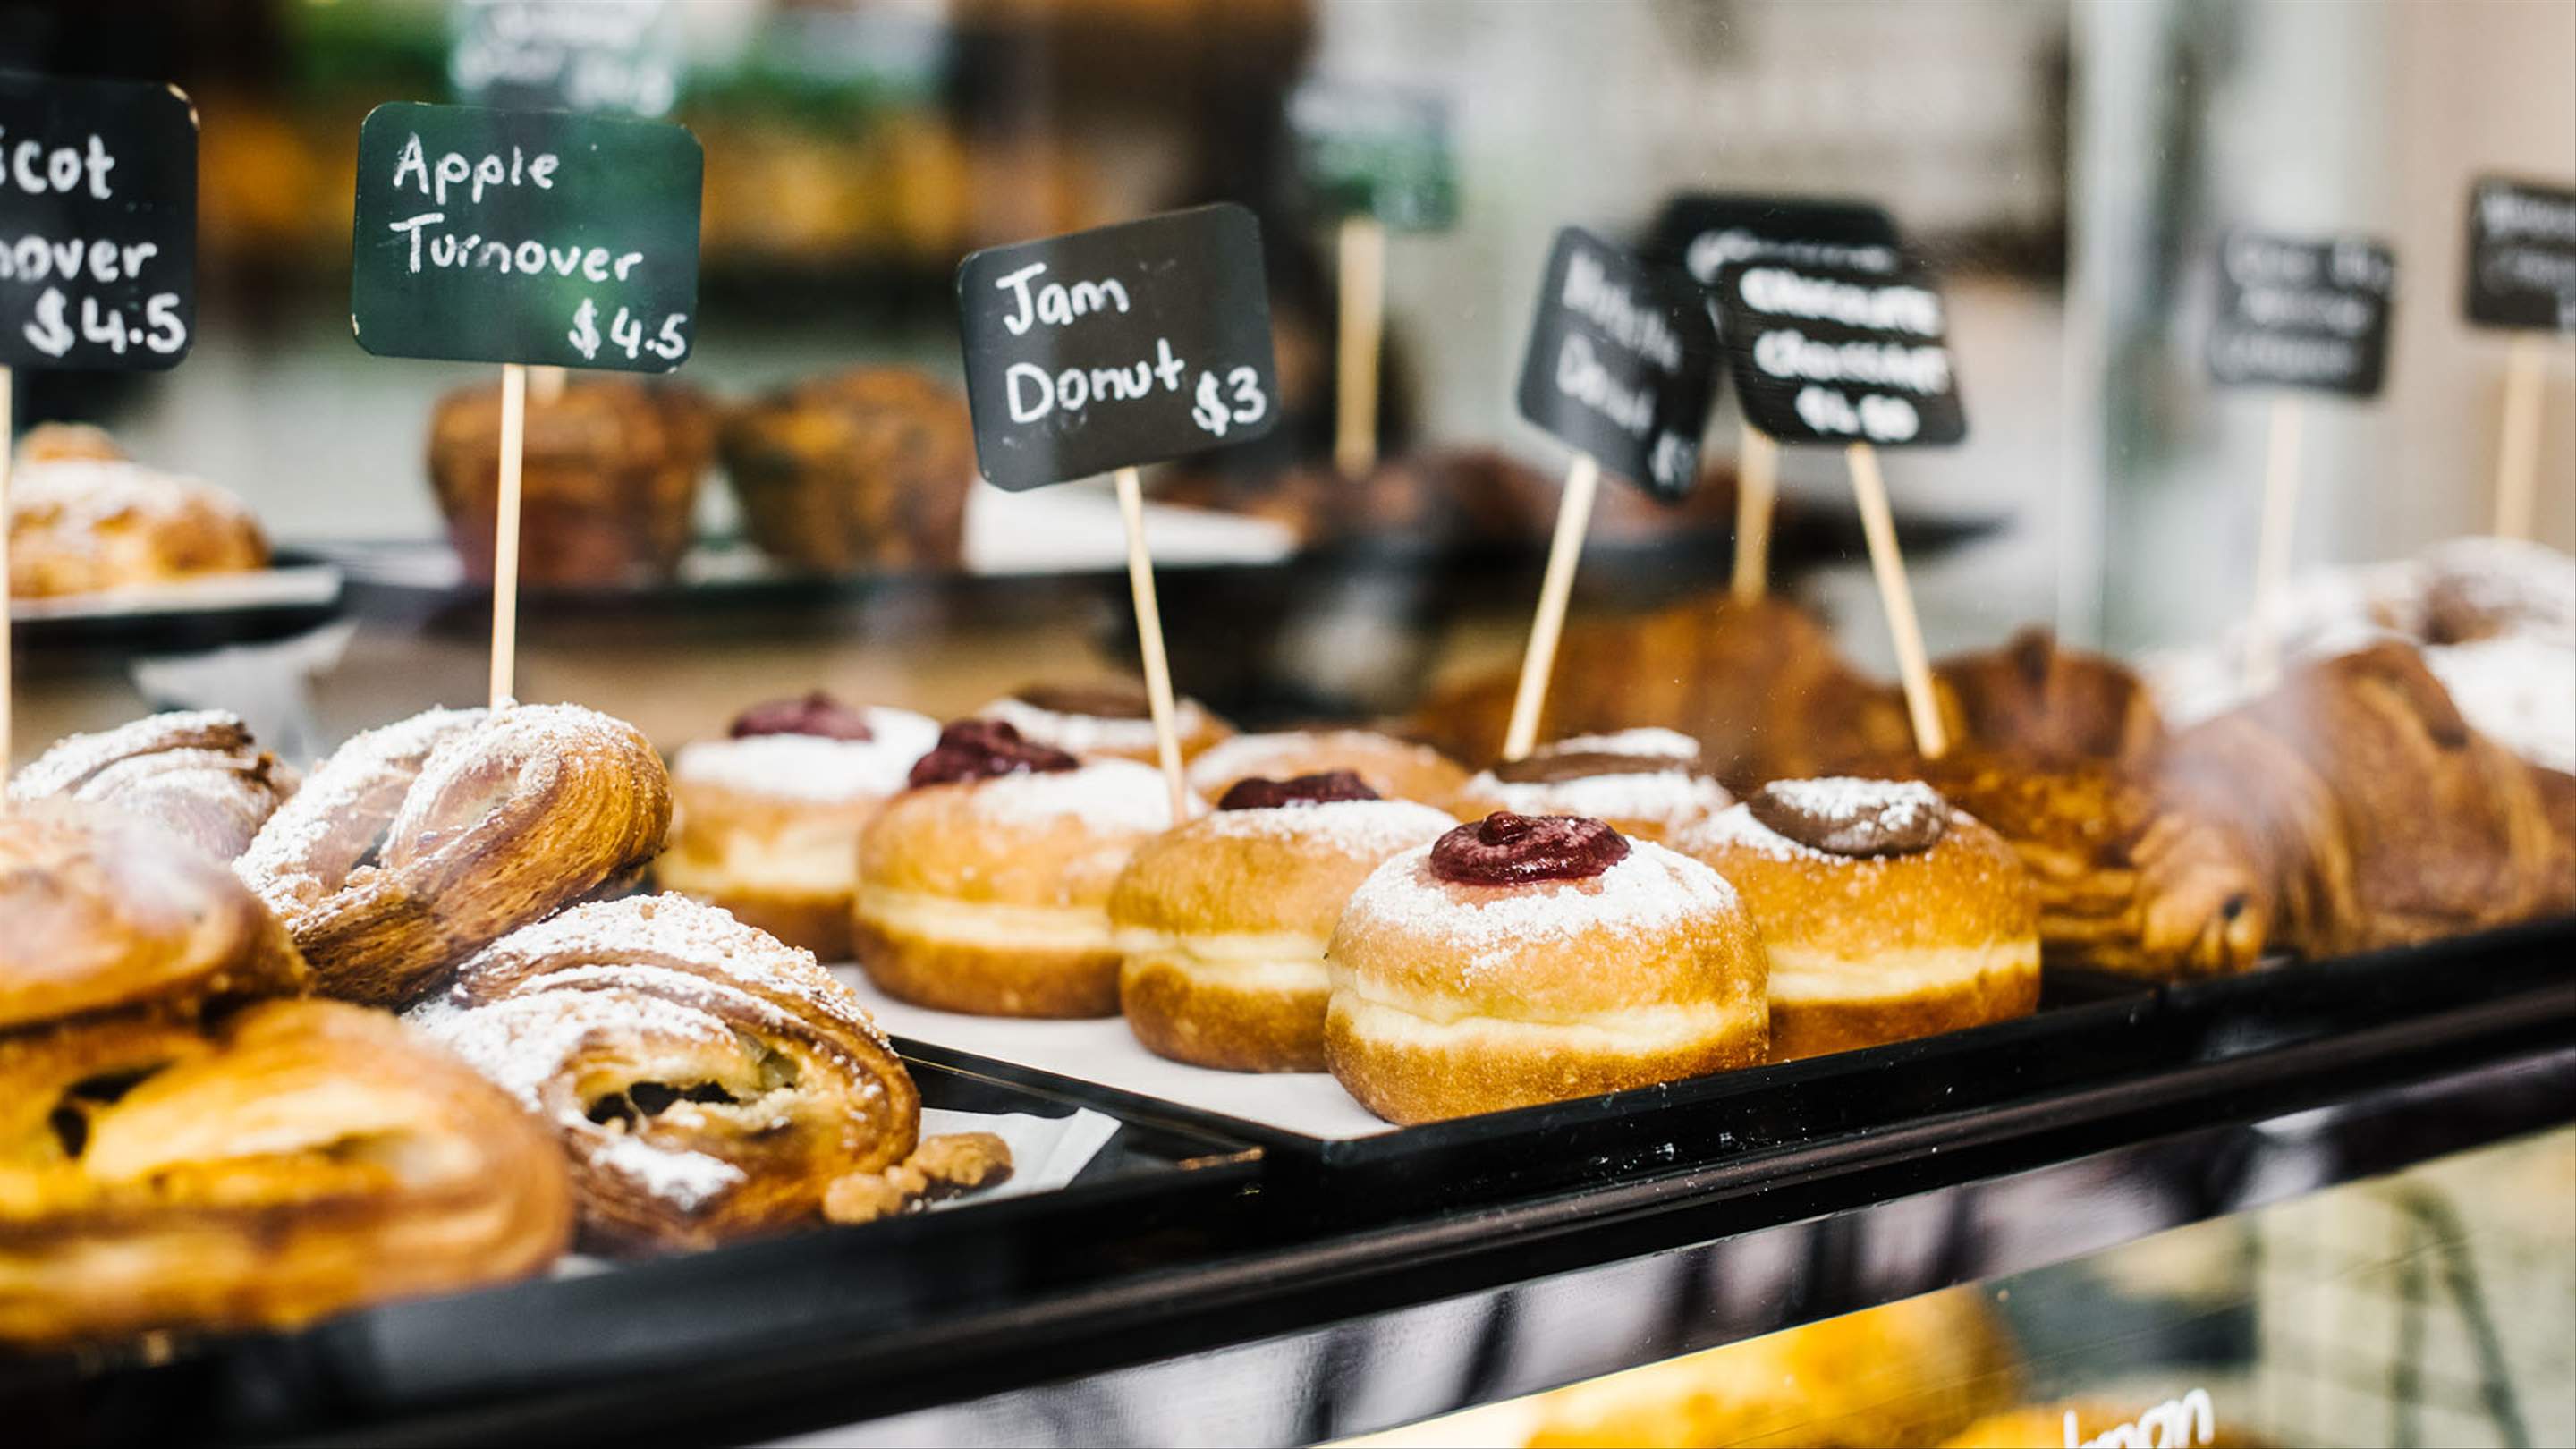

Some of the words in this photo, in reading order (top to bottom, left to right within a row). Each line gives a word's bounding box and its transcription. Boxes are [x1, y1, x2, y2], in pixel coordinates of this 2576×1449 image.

[393, 132, 559, 204] Apple
[388, 212, 643, 281] Turnover
[23, 287, 186, 357] $4.5
[568, 299, 687, 360] $4.5
[996, 262, 1130, 335] Jam
[1005, 337, 1185, 423] Donut
[1192, 365, 1267, 436] $3
